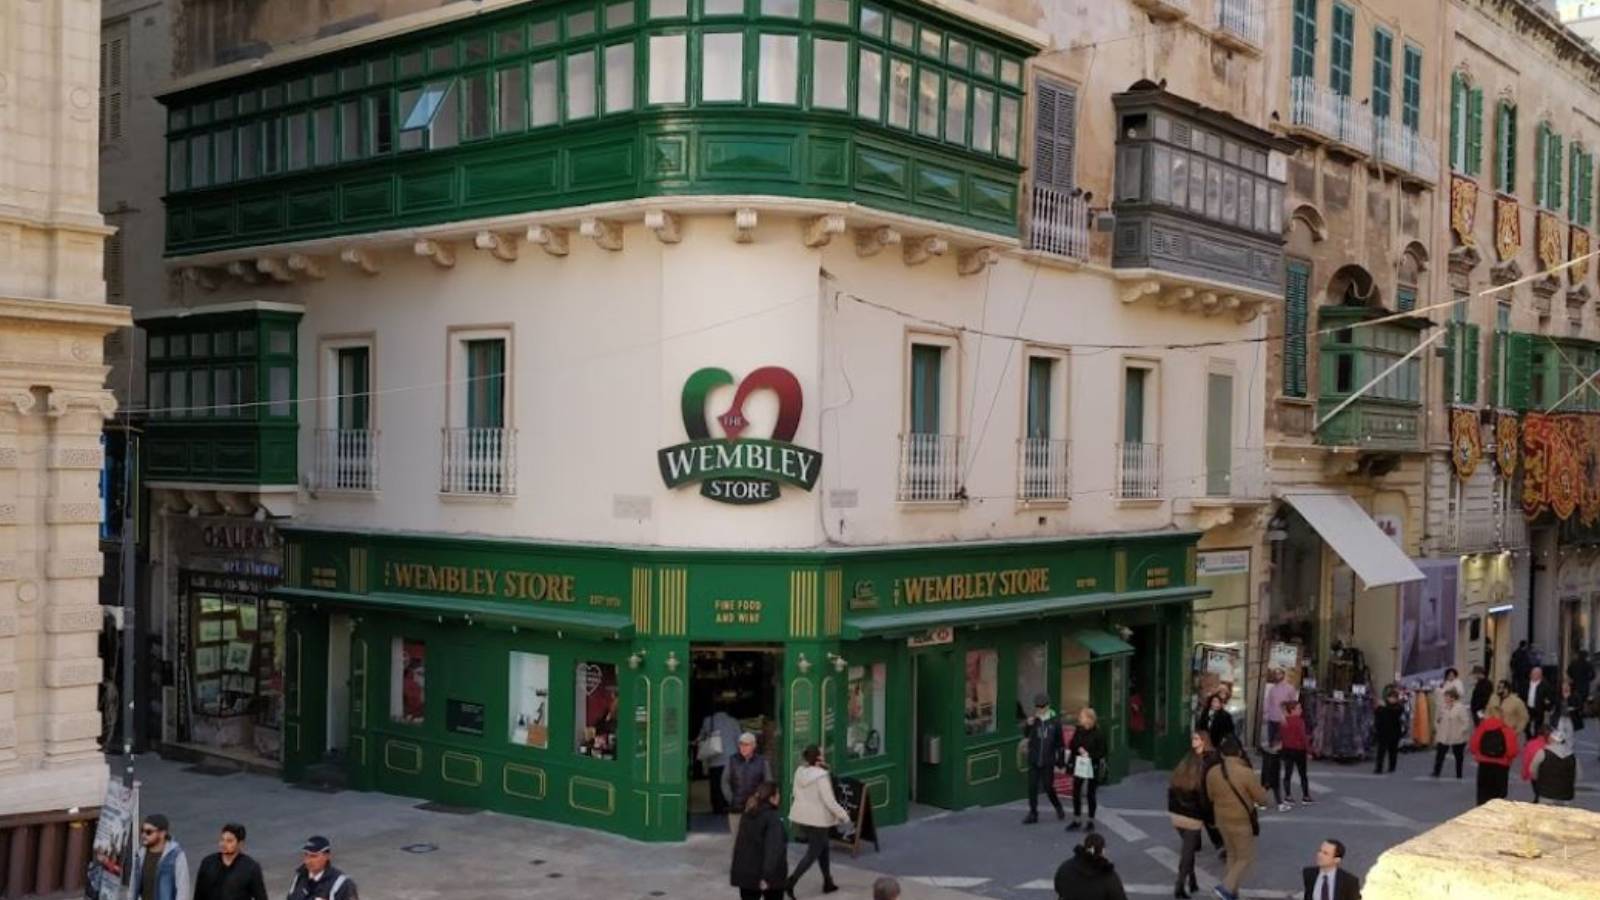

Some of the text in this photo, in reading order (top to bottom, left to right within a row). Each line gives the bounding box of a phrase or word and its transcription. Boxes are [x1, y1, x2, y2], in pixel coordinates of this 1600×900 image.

[724, 415, 742, 426] THE
[666, 444, 814, 482] WEMBLEY
[711, 480, 772, 498] STORE
[395, 563, 498, 596] WEMBLEY
[504, 571, 576, 602] STORE
[904, 572, 996, 604] WEMBLEY
[1000, 568, 1050, 595] STORE
[738, 600, 761, 610] FOOD
[715, 613, 760, 623] AND WINE
